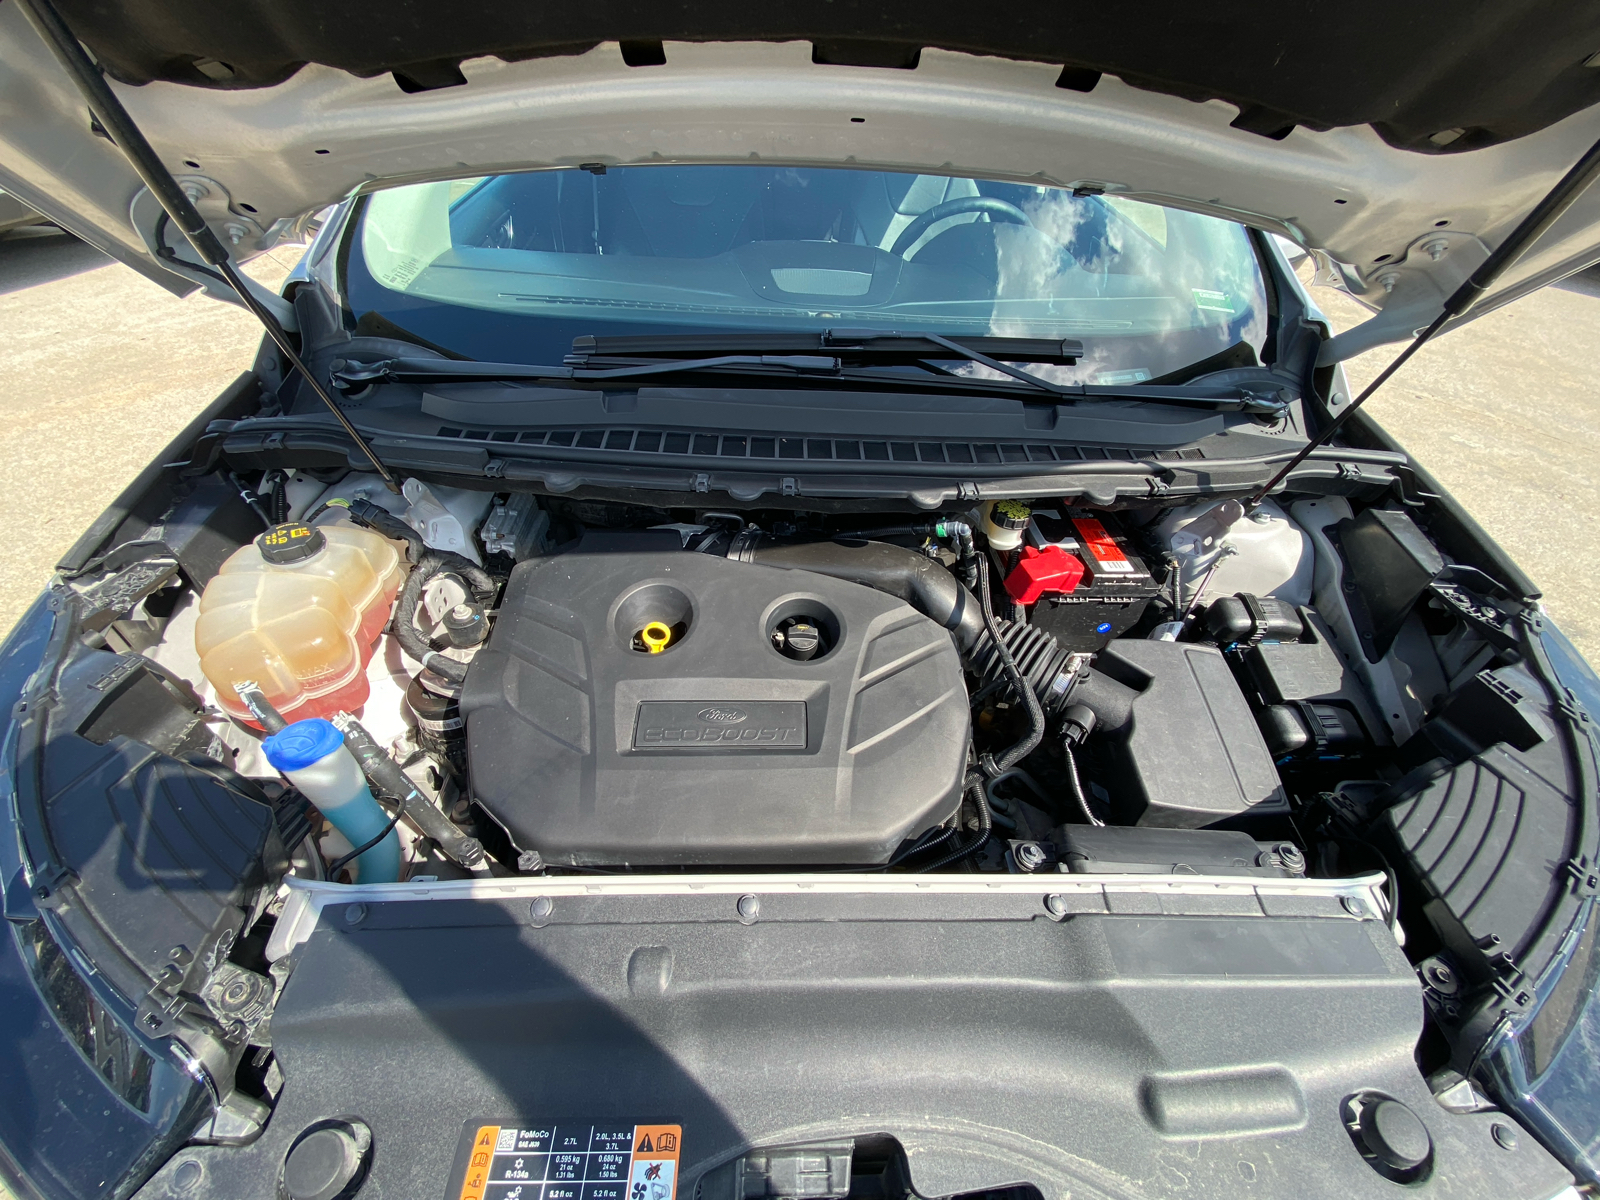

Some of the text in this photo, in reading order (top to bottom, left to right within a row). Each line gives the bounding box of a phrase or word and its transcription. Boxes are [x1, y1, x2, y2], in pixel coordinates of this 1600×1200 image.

[706, 708, 738, 720] Ford
[520, 1130, 549, 1138] FoMoCo
[596, 1132, 610, 1140] 2.0L,
[612, 1132, 625, 1140] 3.5L
[556, 1155, 580, 1164] 0.595 kg
[615, 1155, 622, 1164] kg
[505, 1170, 529, 1179] R-134a
[549, 1190, 558, 1198] 5.2
